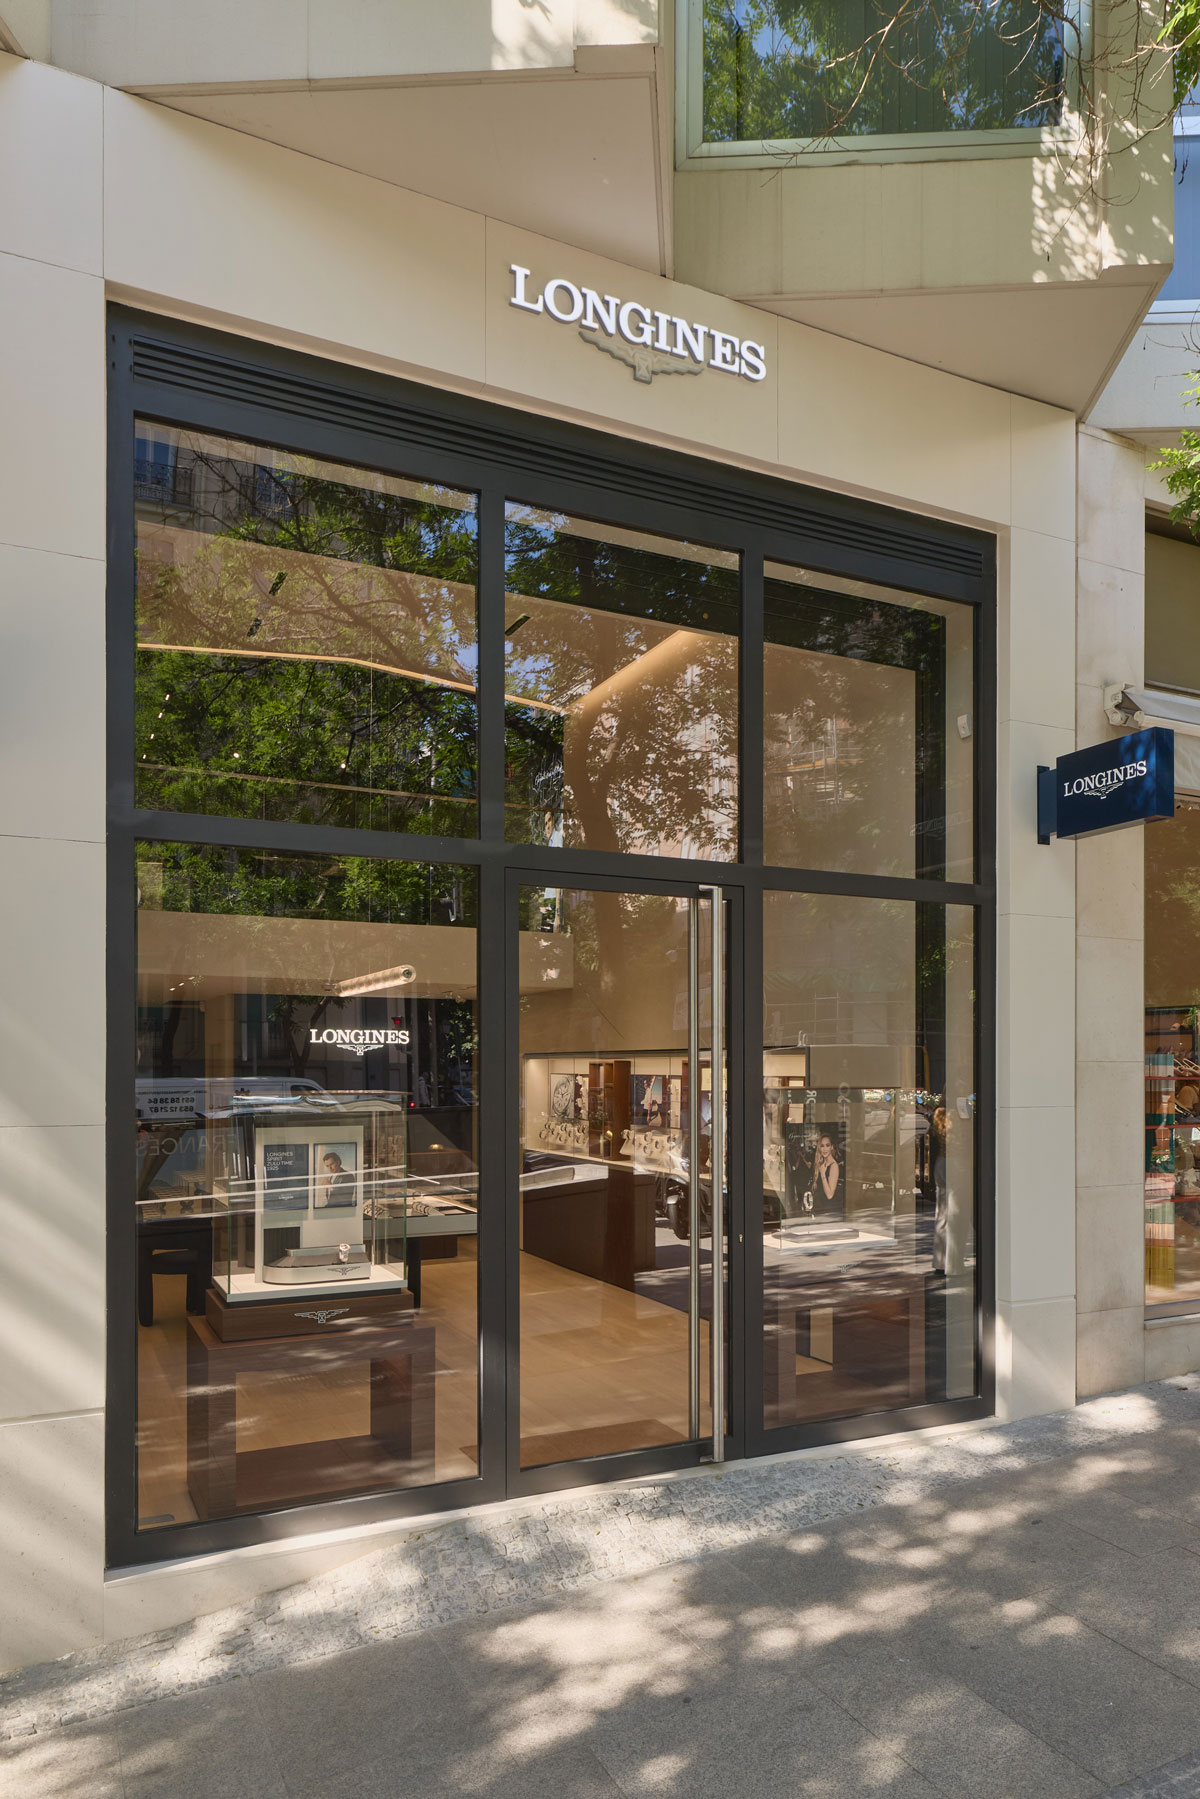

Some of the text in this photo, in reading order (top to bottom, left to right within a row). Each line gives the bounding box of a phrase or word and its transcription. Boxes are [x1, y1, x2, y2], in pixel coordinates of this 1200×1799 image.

[509, 264, 767, 382] LONGINES
[1063, 760, 1147, 797] LONGINES
[309, 1028, 410, 1044] LONGINES
